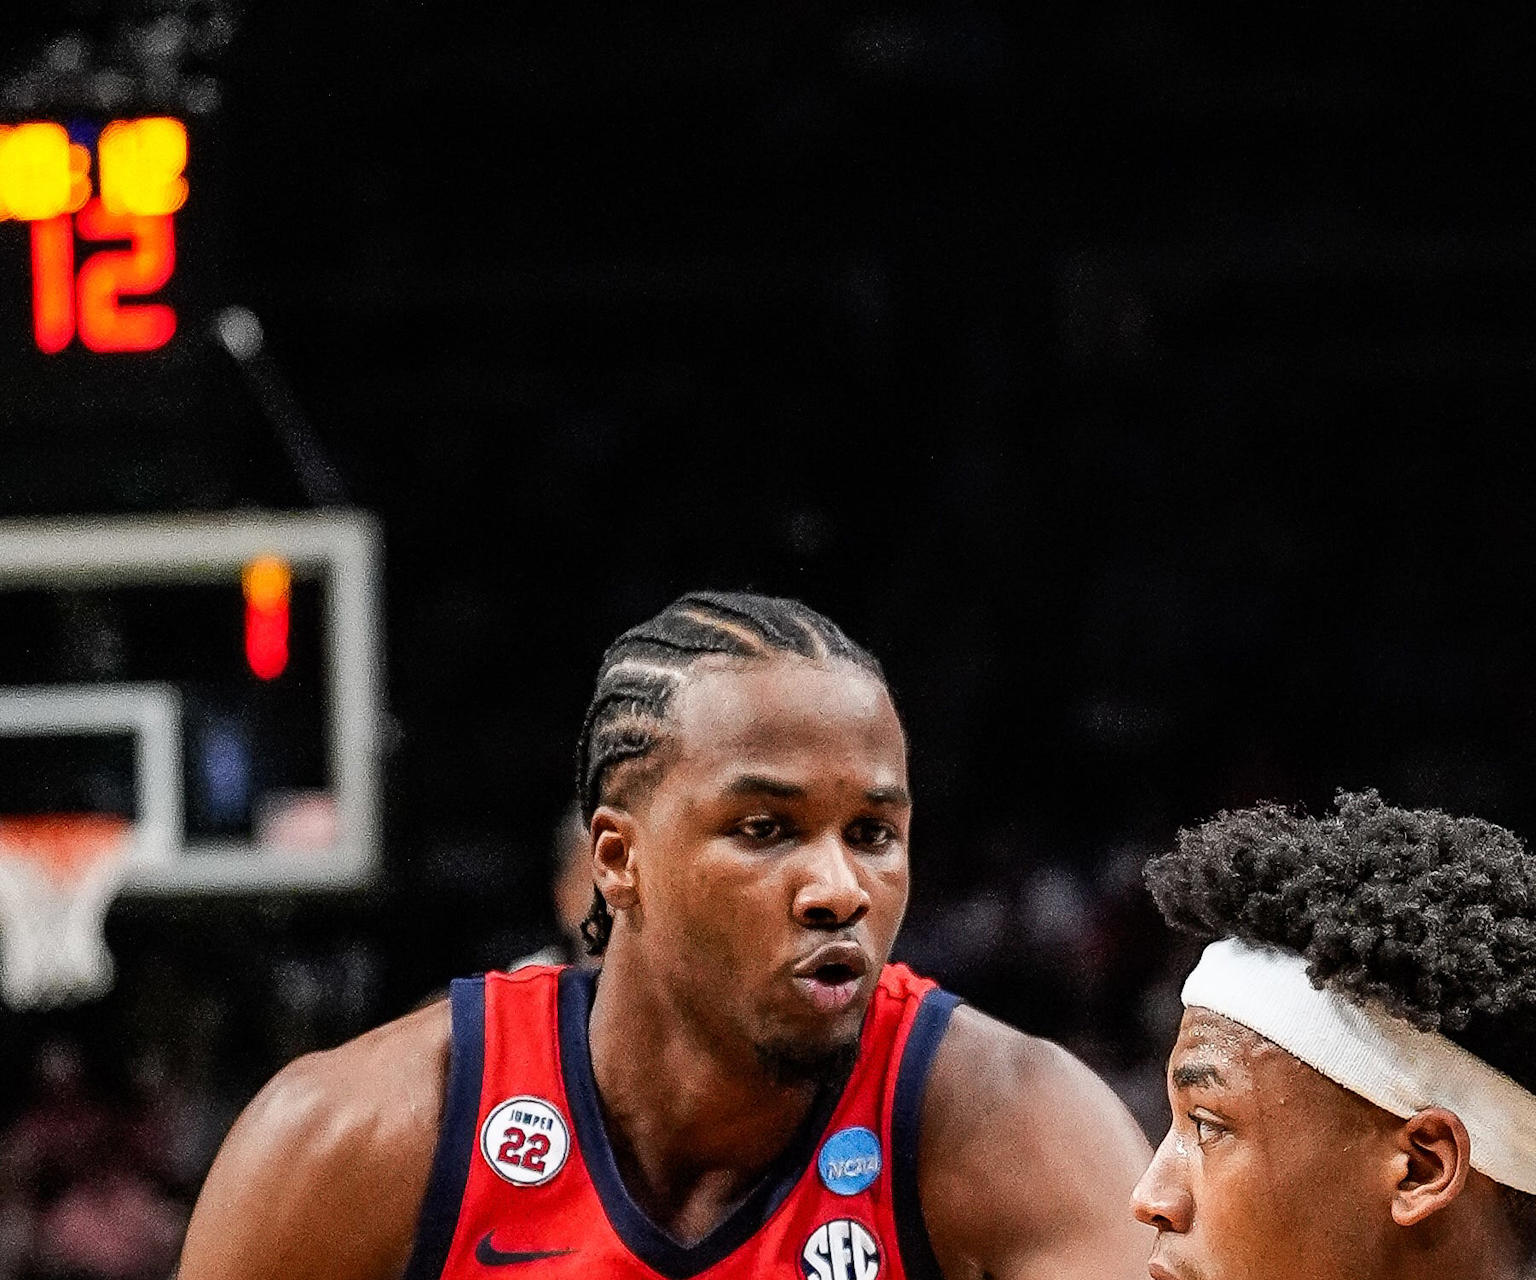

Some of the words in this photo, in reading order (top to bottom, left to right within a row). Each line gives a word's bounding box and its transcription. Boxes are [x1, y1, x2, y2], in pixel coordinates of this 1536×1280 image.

[508, 1109, 554, 1131] JUMPER
[497, 1127, 551, 1175] 22
[827, 1156, 880, 1180] NCAA
